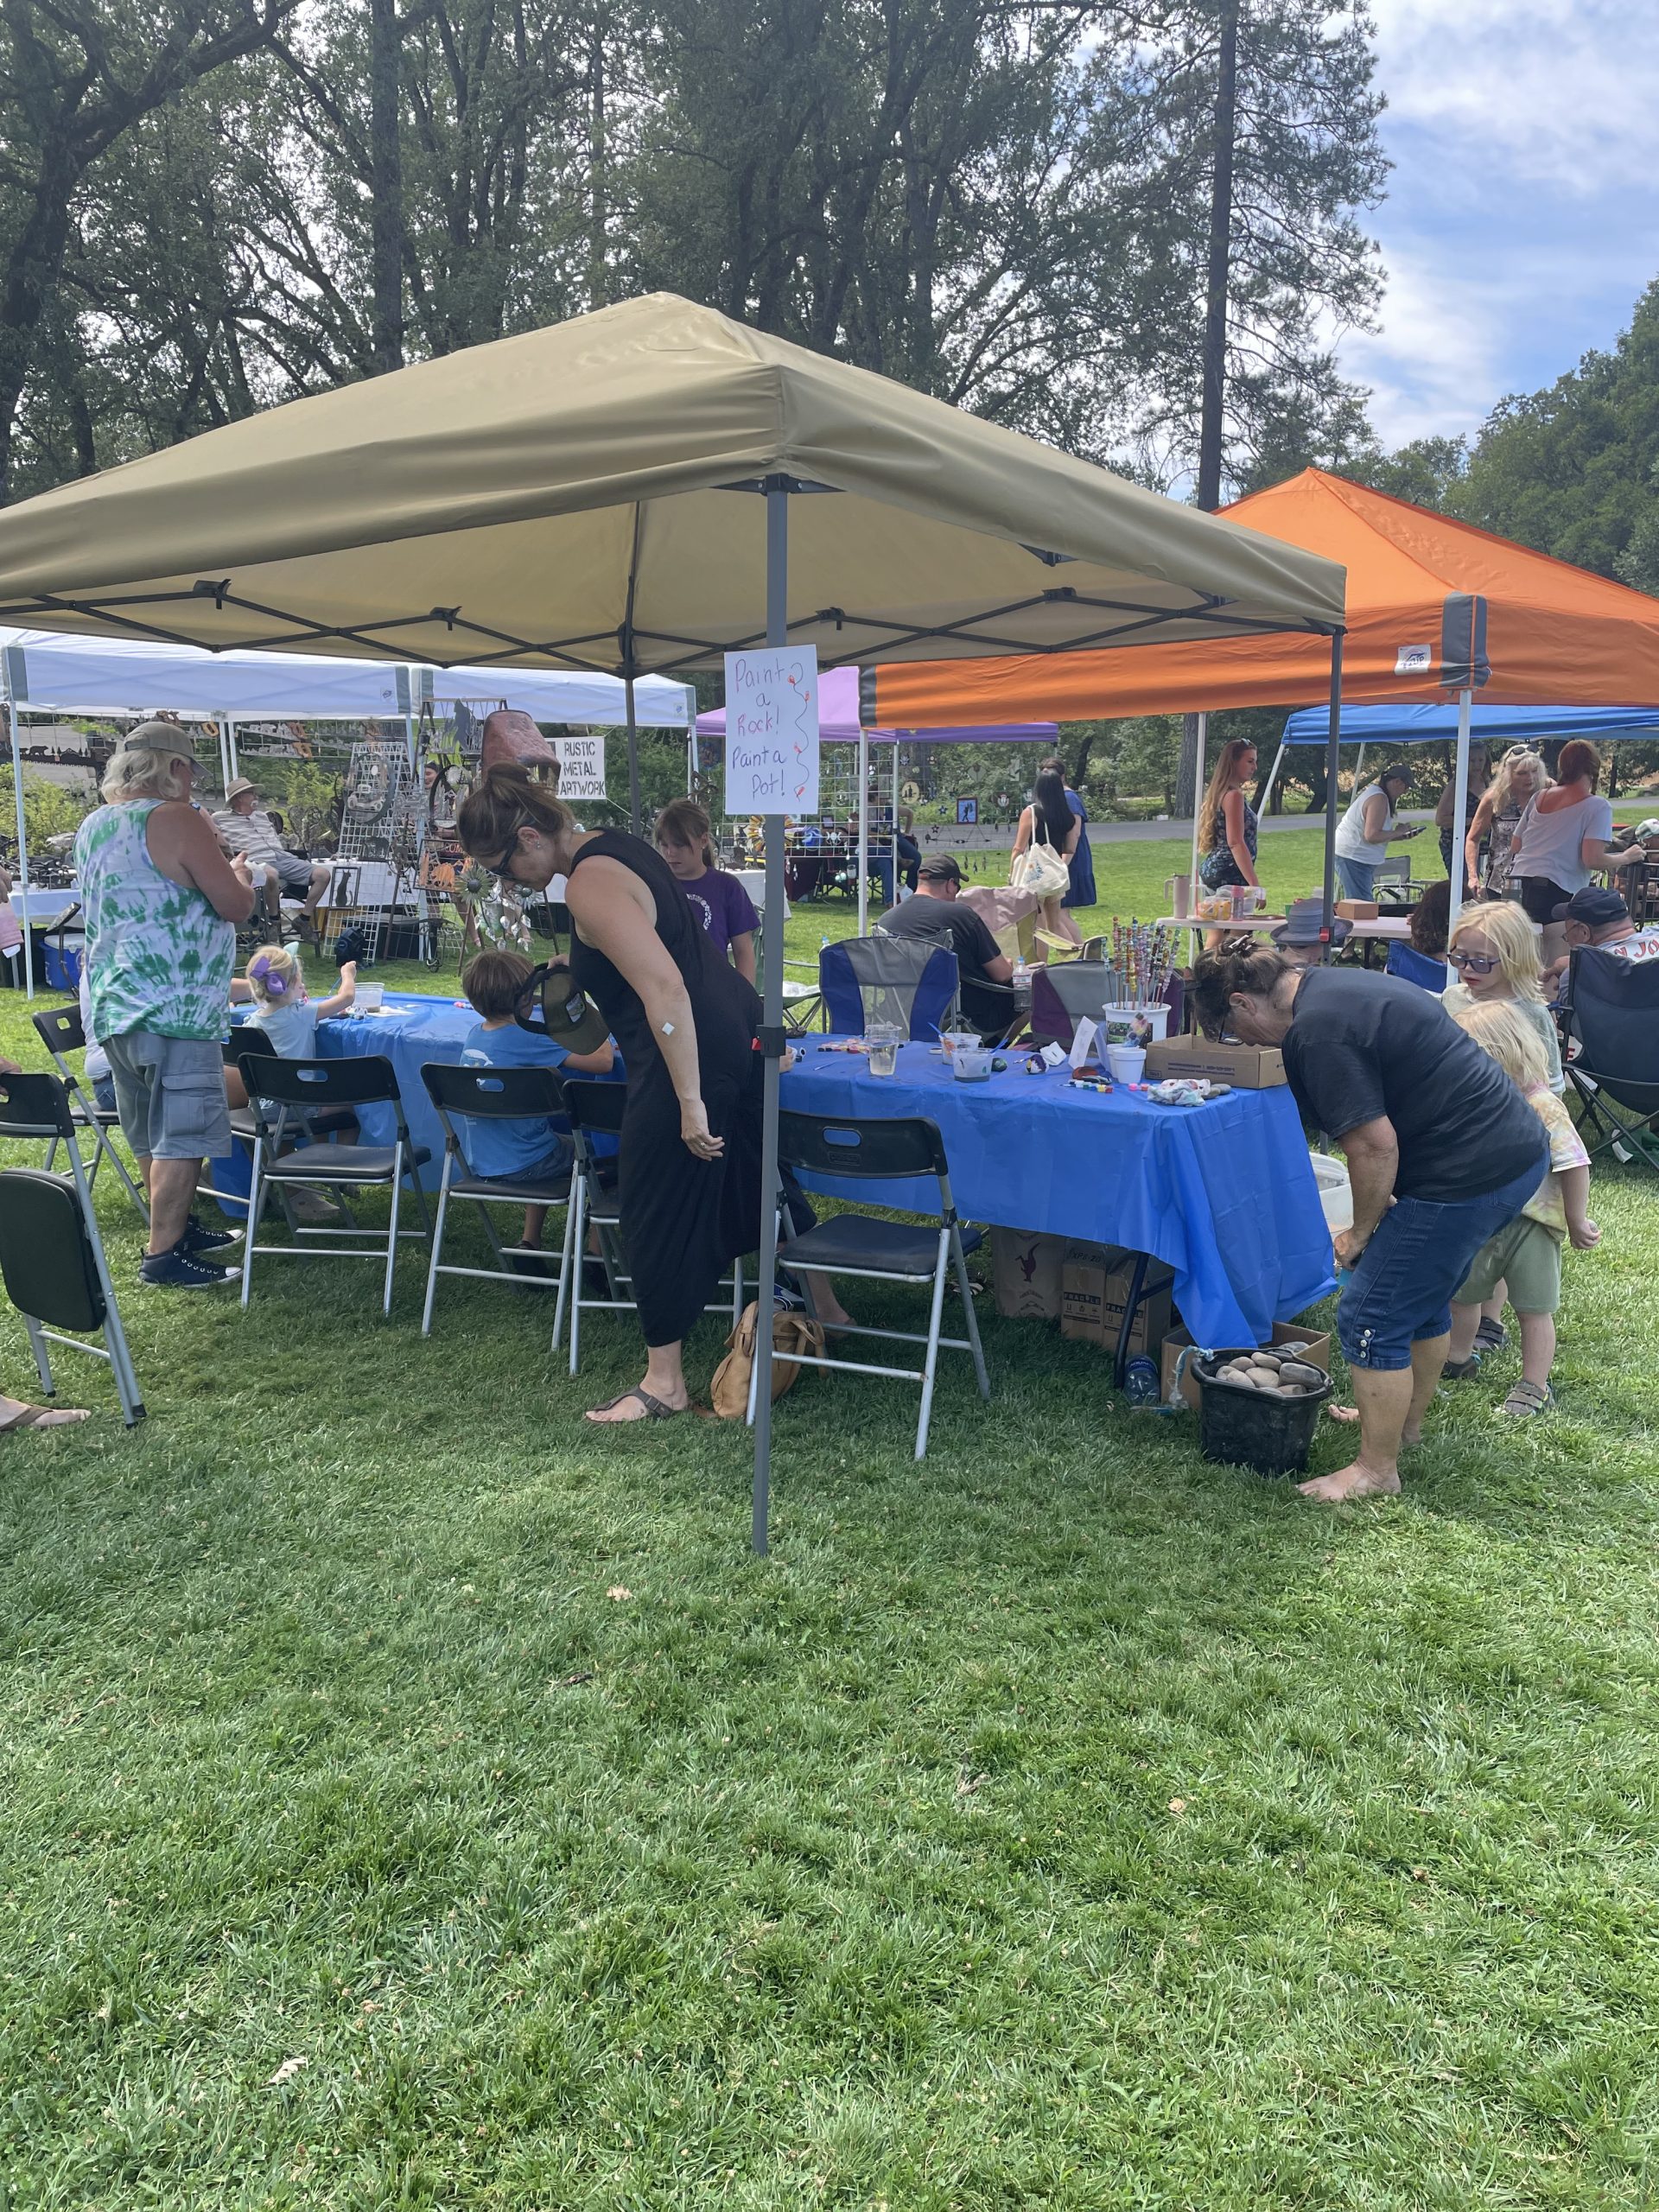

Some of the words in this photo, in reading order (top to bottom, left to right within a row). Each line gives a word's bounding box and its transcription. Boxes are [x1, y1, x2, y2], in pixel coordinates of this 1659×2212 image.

[735, 657, 785, 692] Paint
[756, 692, 771, 707] a
[738, 705, 779, 736] Rock!
[564, 741, 595, 756] RUSTIC
[733, 746, 770, 769] Paint
[773, 750, 786, 764] a
[563, 761, 597, 776] METAL
[560, 780, 606, 796] ARTWORK
[752, 769, 785, 801] Pot!
[1106, 1304, 1143, 1318] FRAGE
